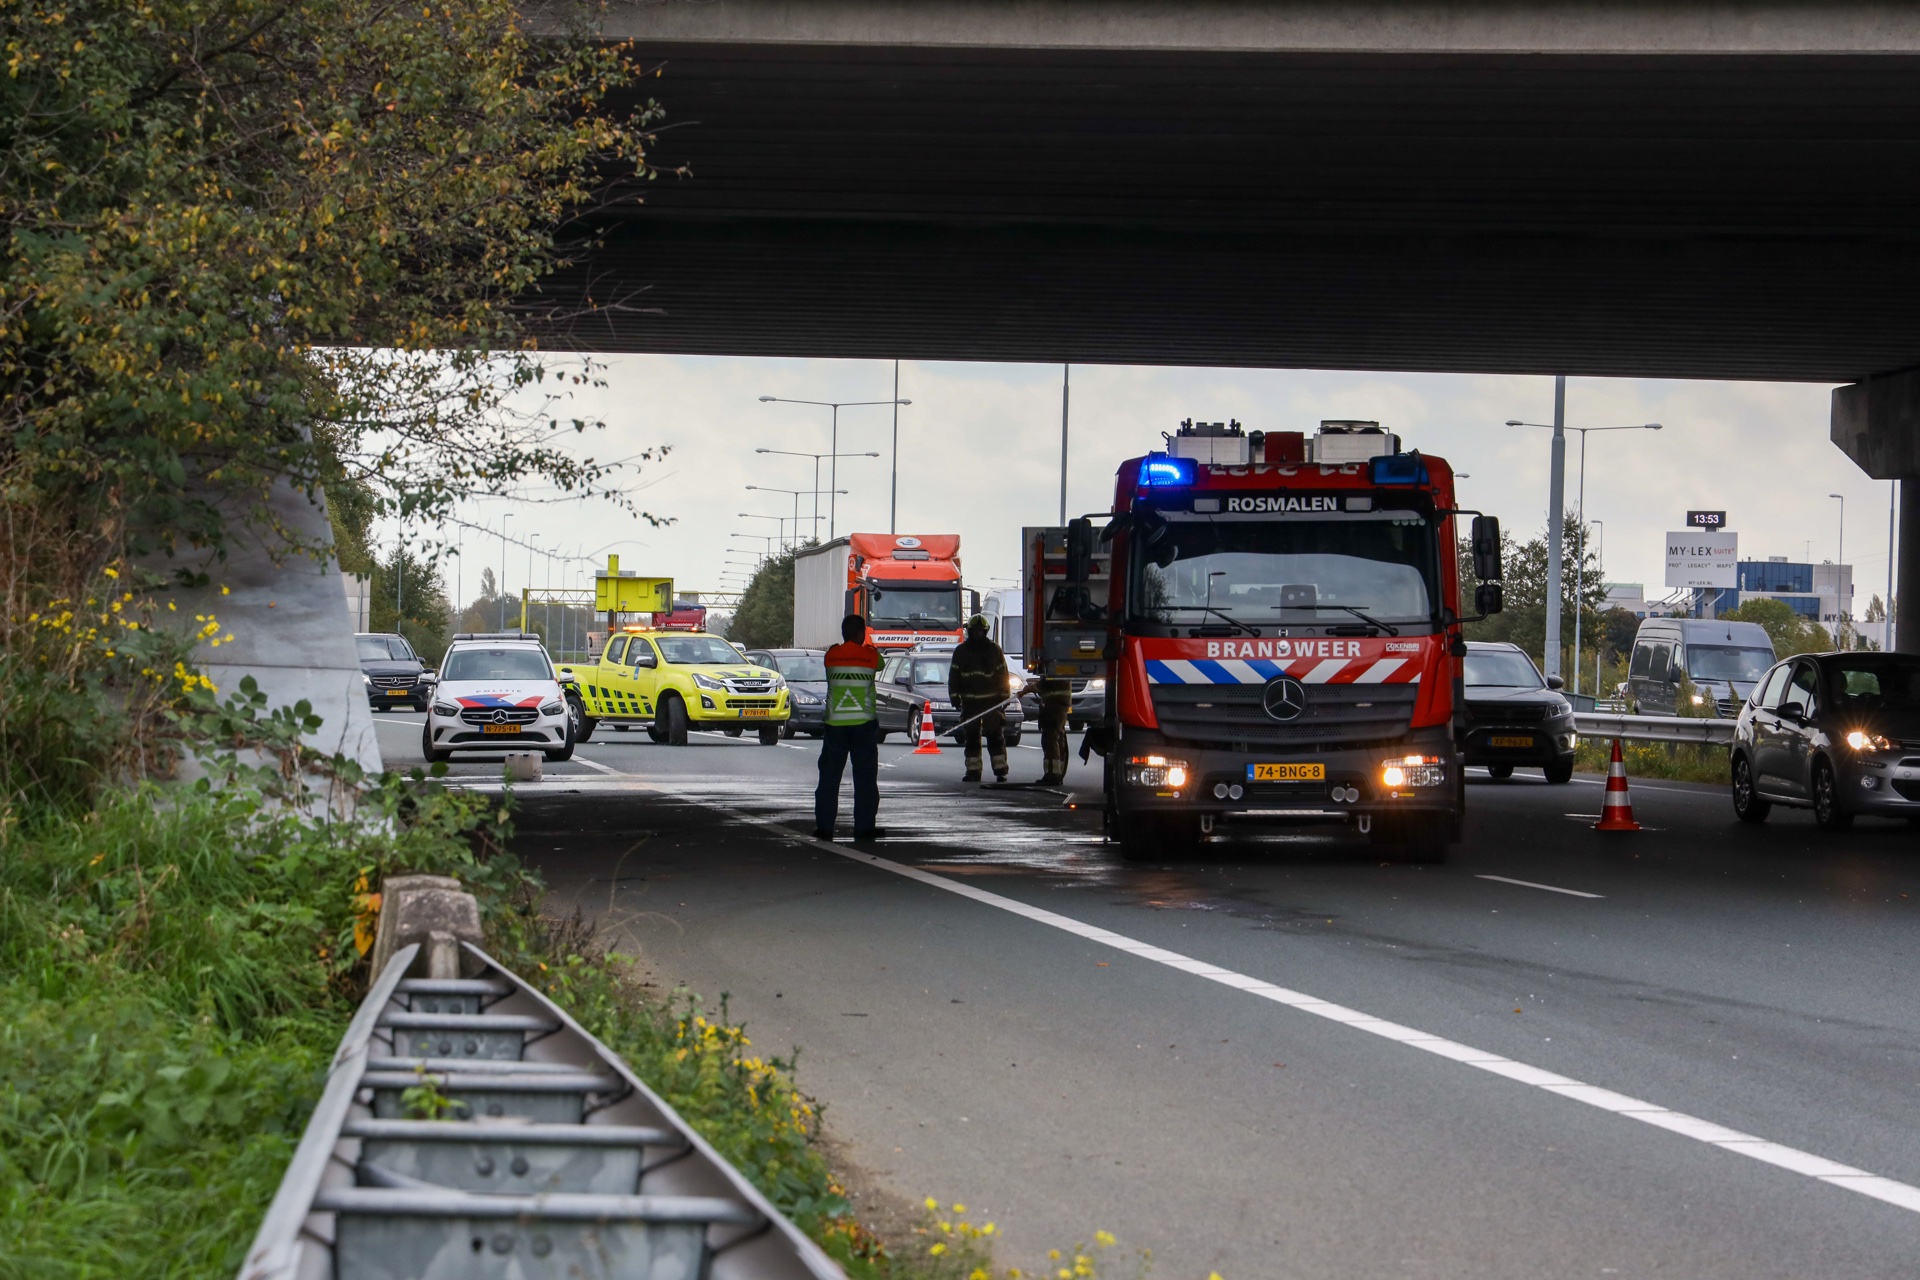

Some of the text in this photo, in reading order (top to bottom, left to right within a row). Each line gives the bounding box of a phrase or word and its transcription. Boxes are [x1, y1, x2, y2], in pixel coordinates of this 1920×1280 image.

[1228, 497, 1337, 511] ROSMALEN
[1694, 514, 1719, 524] 13:53
[1207, 641, 1362, 658] BRANDWEER
[1257, 766, 1321, 778] 74-BNG-8
